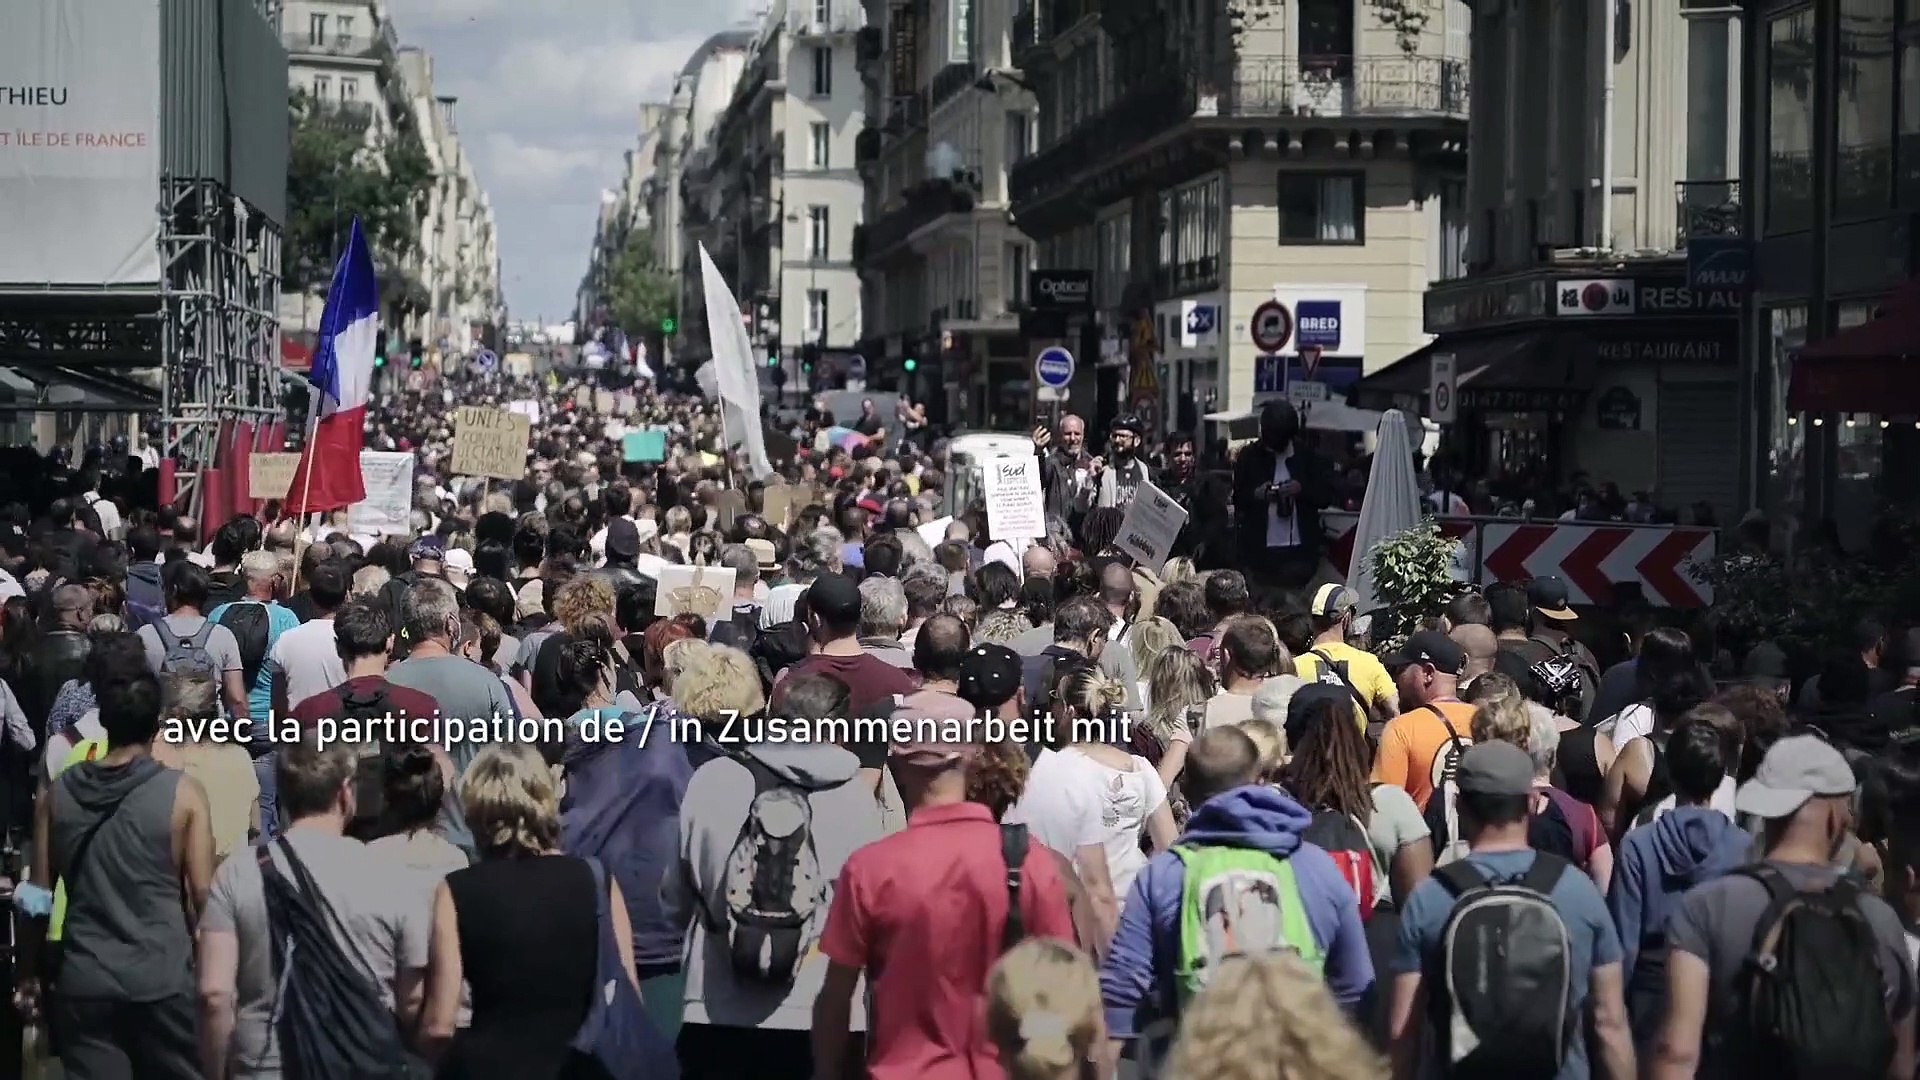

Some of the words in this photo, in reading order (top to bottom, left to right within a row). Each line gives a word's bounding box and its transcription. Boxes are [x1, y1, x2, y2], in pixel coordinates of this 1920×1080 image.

[958, 0, 970, 46] TEL
[47, 132, 70, 147] DE
[75, 132, 147, 147] FRANCE
[1040, 277, 1089, 297] Optical
[1299, 316, 1338, 330] BRED
[1597, 341, 1721, 360] RESTAURANT
